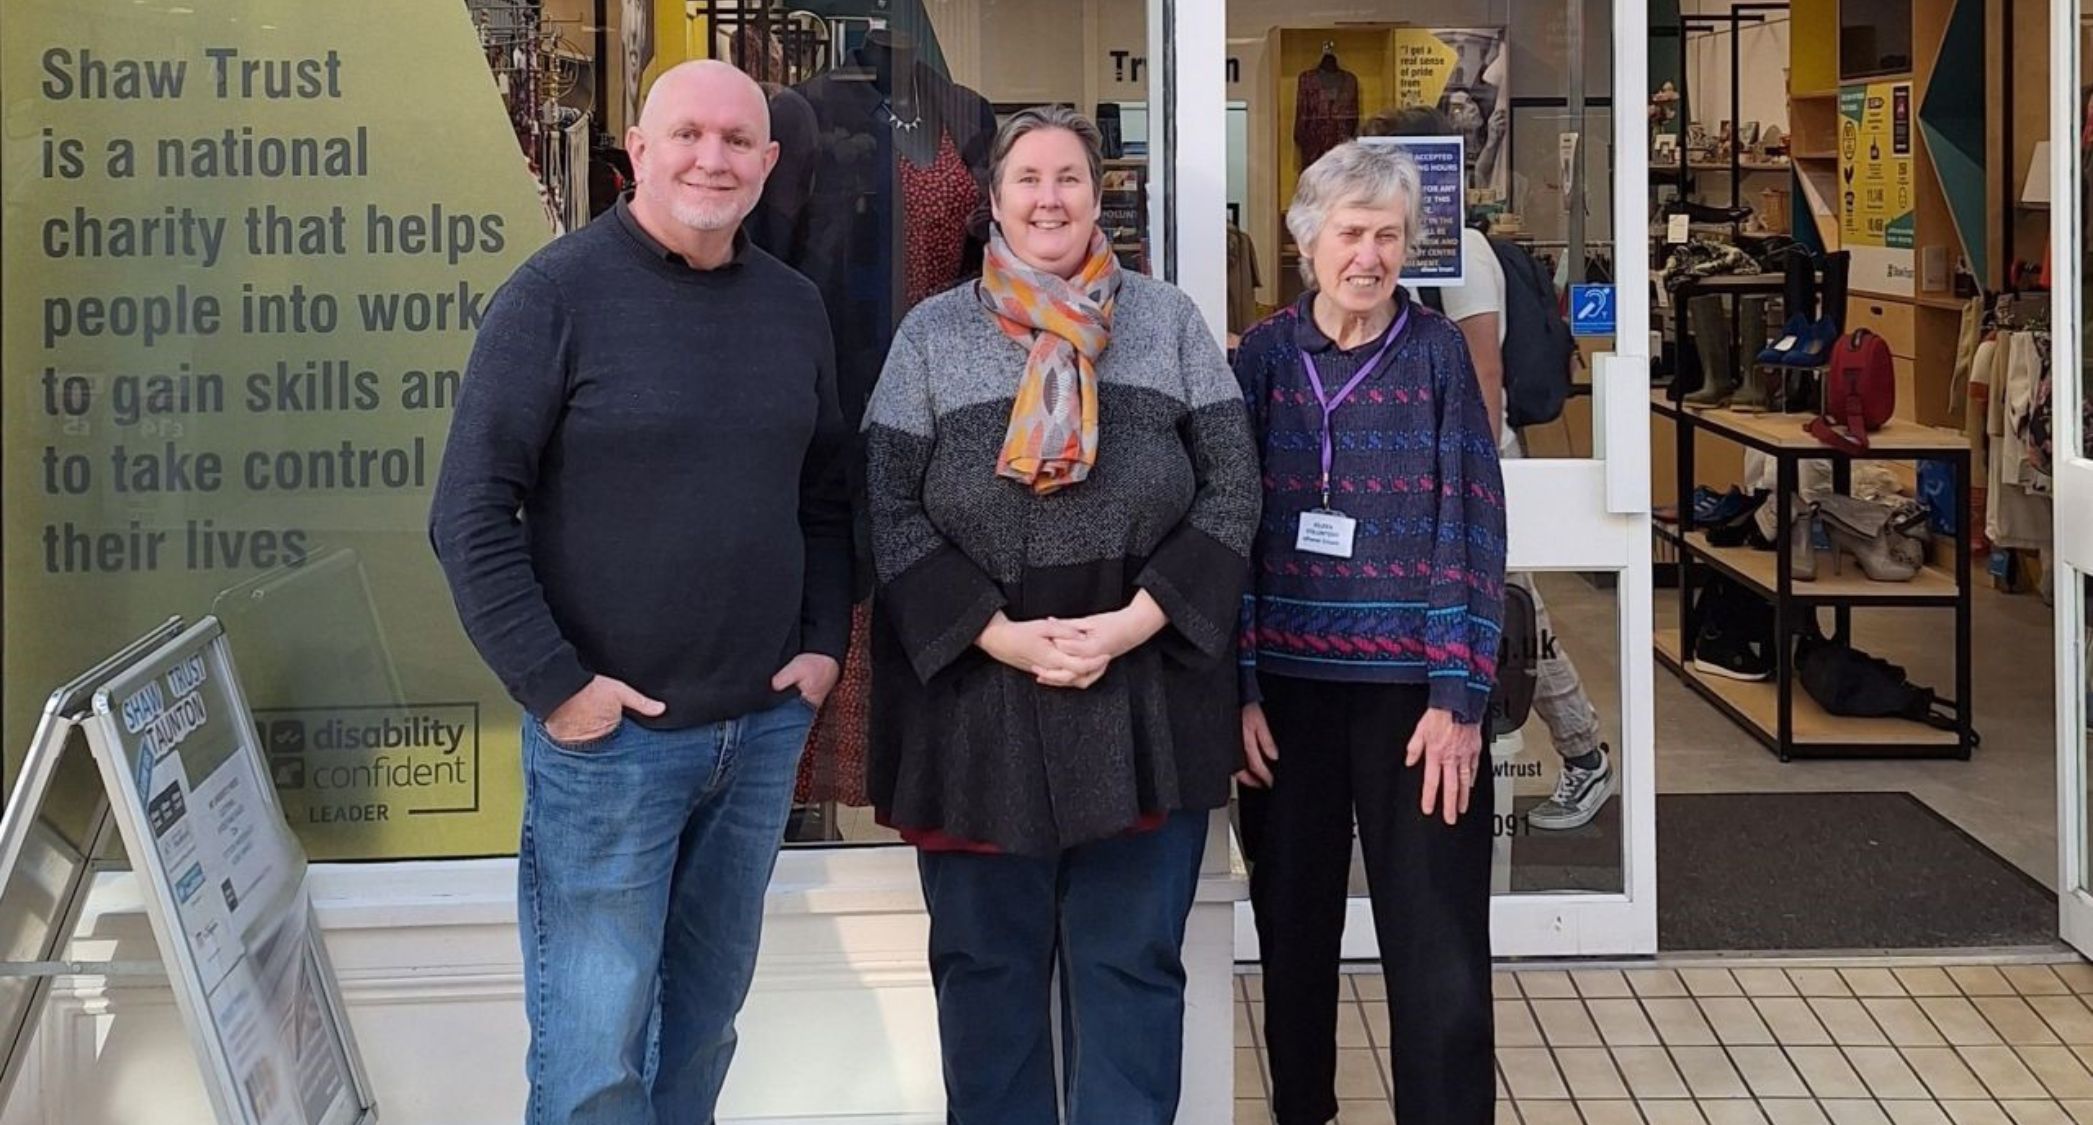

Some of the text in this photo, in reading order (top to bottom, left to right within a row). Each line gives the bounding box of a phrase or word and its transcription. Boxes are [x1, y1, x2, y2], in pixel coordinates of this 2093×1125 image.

[42, 48, 341, 100] Shaw Trust
[1110, 51, 1146, 82] Tr
[42, 126, 368, 179] is a national
[1414, 153, 1453, 161] ACCEPTED
[1431, 163, 1457, 172] HOURS
[1440, 185, 1456, 193] ANY
[42, 203, 505, 267] charity that helps
[43, 281, 484, 348] people into work
[42, 360, 460, 426] to gain skills an
[43, 437, 425, 494] to take control
[43, 520, 308, 574] their lives
[124, 655, 206, 731] SHAW TRUST
[145, 691, 205, 754] TAUNTON
[314, 717, 465, 754] disability
[314, 756, 466, 788] confident
[309, 804, 389, 823] LEADER
